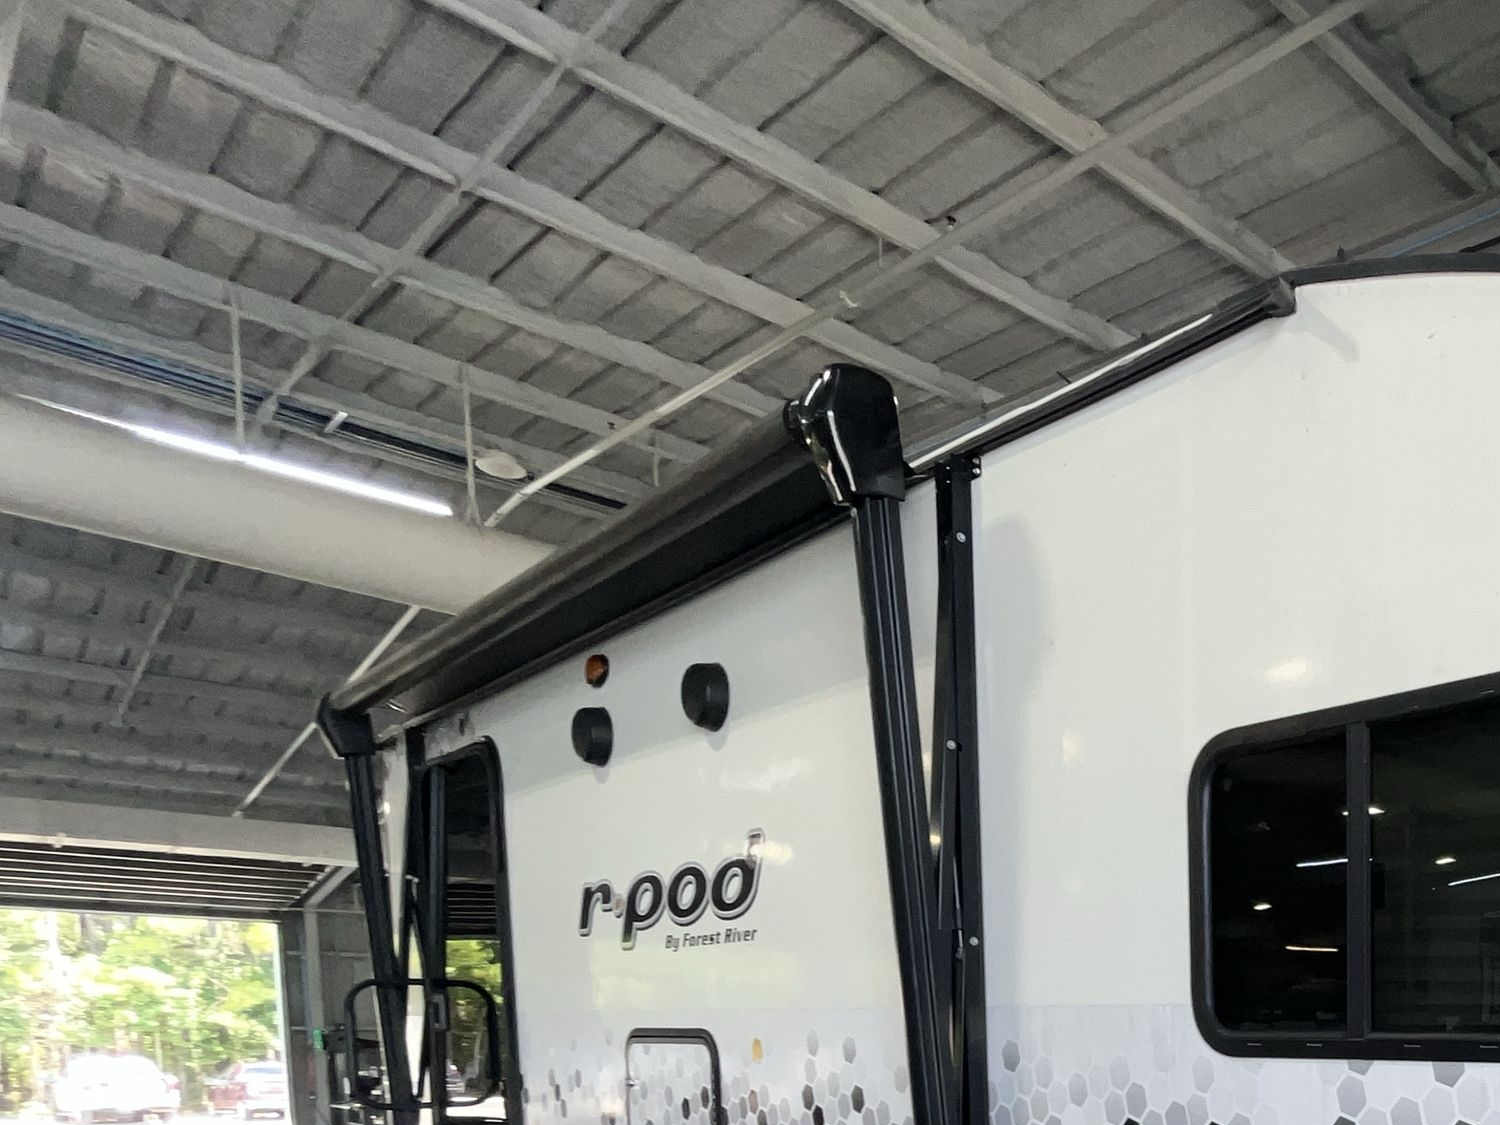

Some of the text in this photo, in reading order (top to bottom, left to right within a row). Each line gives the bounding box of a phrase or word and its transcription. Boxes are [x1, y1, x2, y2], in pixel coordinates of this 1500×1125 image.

[665, 927, 758, 952] By Forest River
